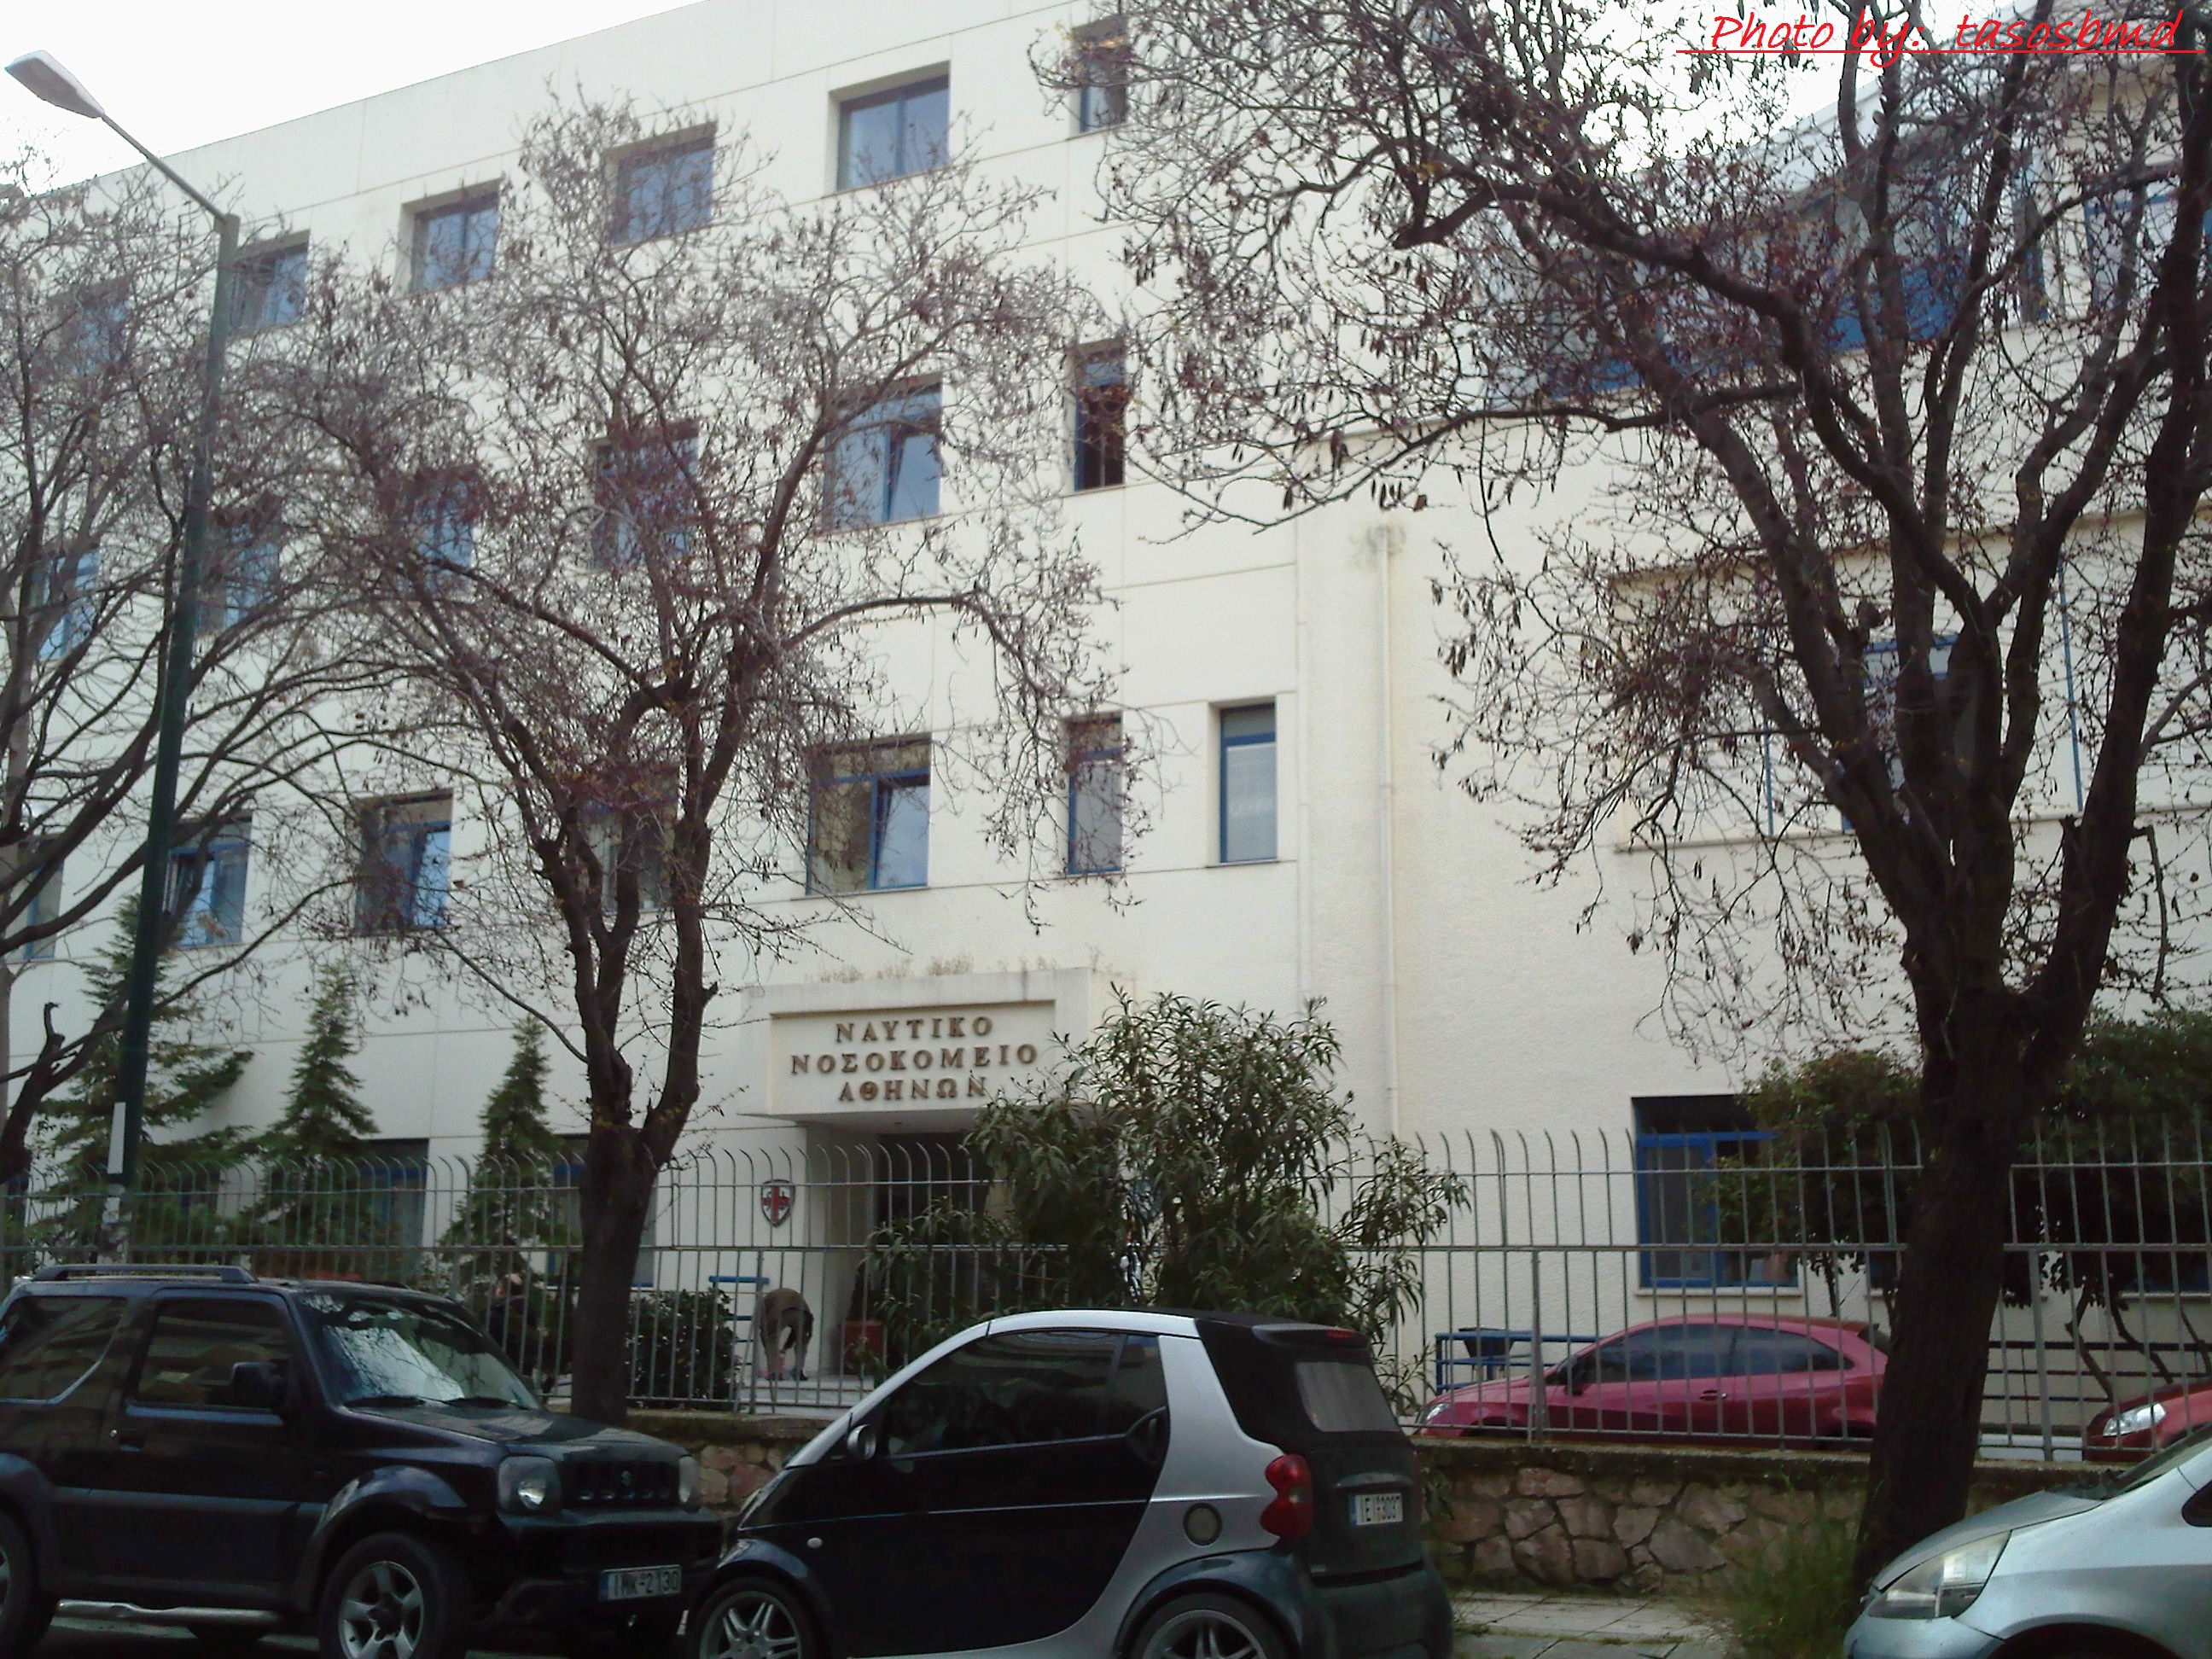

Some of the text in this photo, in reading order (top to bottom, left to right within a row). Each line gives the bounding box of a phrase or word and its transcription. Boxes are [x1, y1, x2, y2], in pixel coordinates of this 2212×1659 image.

[835, 1016, 993, 1043] ΝΑΥΤΙΚΟ
[791, 1043, 1038, 1075] ΝΟΣΟΚΟΜΕΙΟ
[838, 1076, 987, 1102] ΑΘΗΝΩΝ
